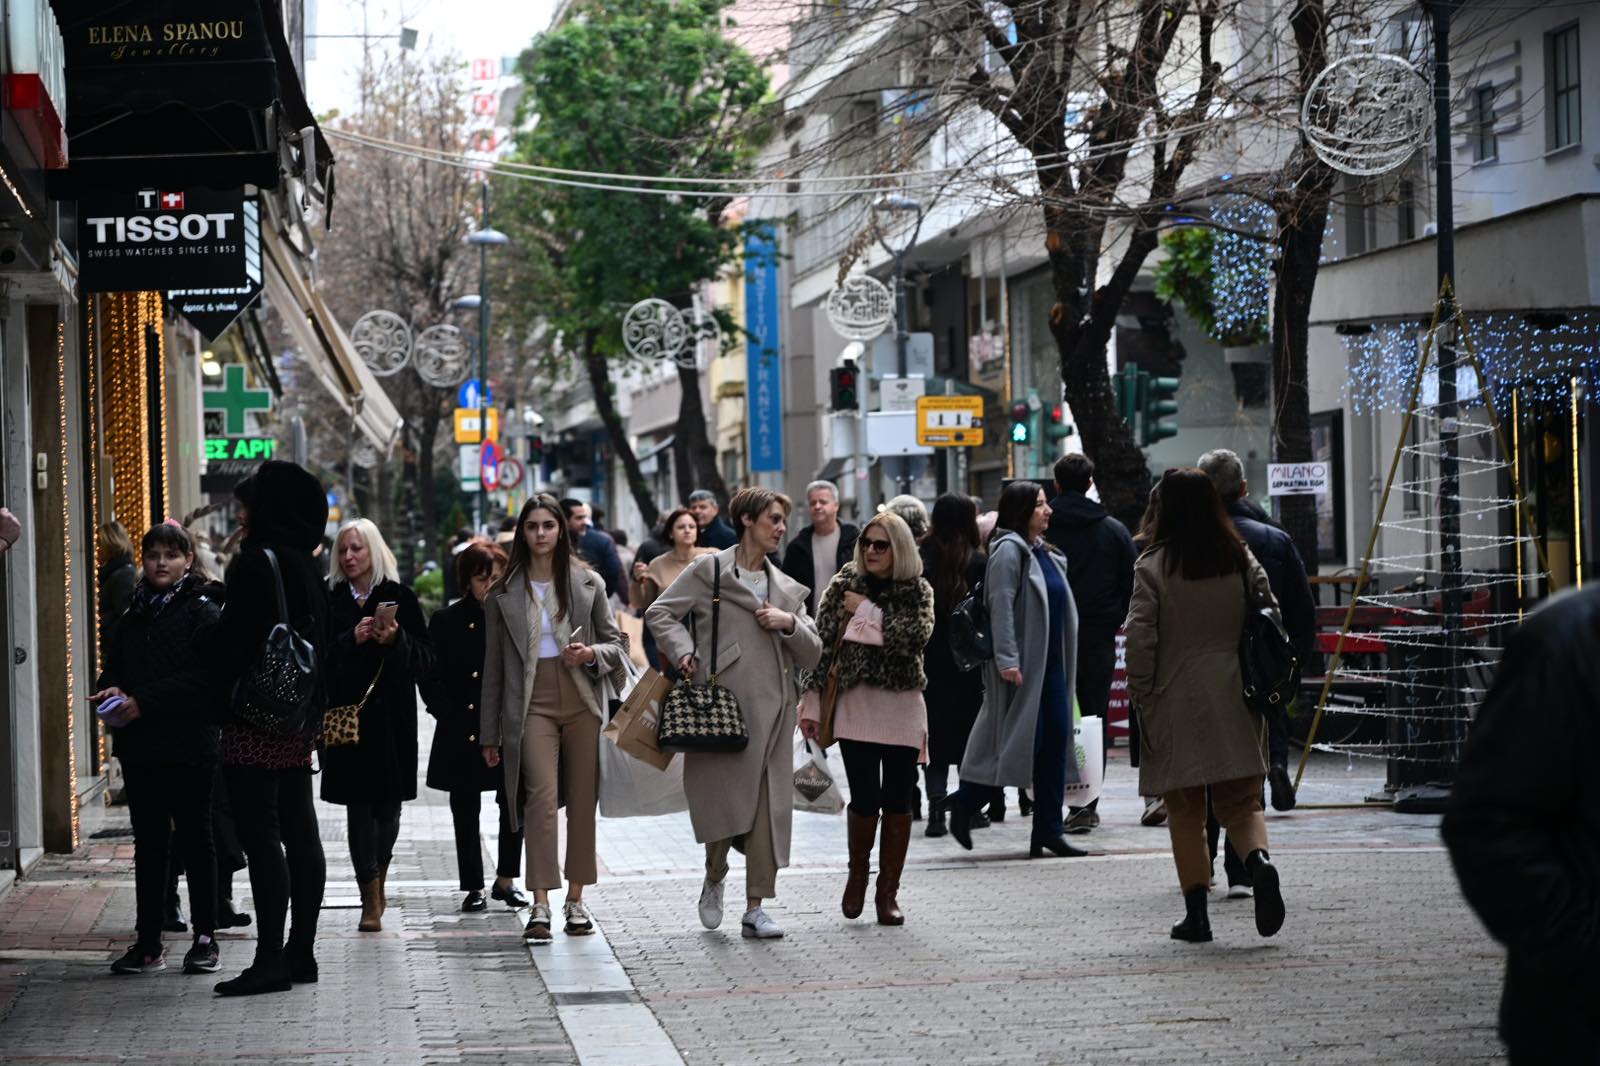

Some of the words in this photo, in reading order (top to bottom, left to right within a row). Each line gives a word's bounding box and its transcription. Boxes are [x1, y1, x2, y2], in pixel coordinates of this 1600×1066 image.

[88, 25, 153, 44] ELENA
[163, 21, 244, 41] SPANOU
[86, 213, 235, 243] TISSOT
[87, 249, 121, 258] SWISS
[125, 247, 173, 256] WATCHES
[178, 246, 209, 255] SINCE
[214, 245, 236, 254] 1853
[206, 303, 214, 312] &
[1271, 465, 1326, 478] MILANO
